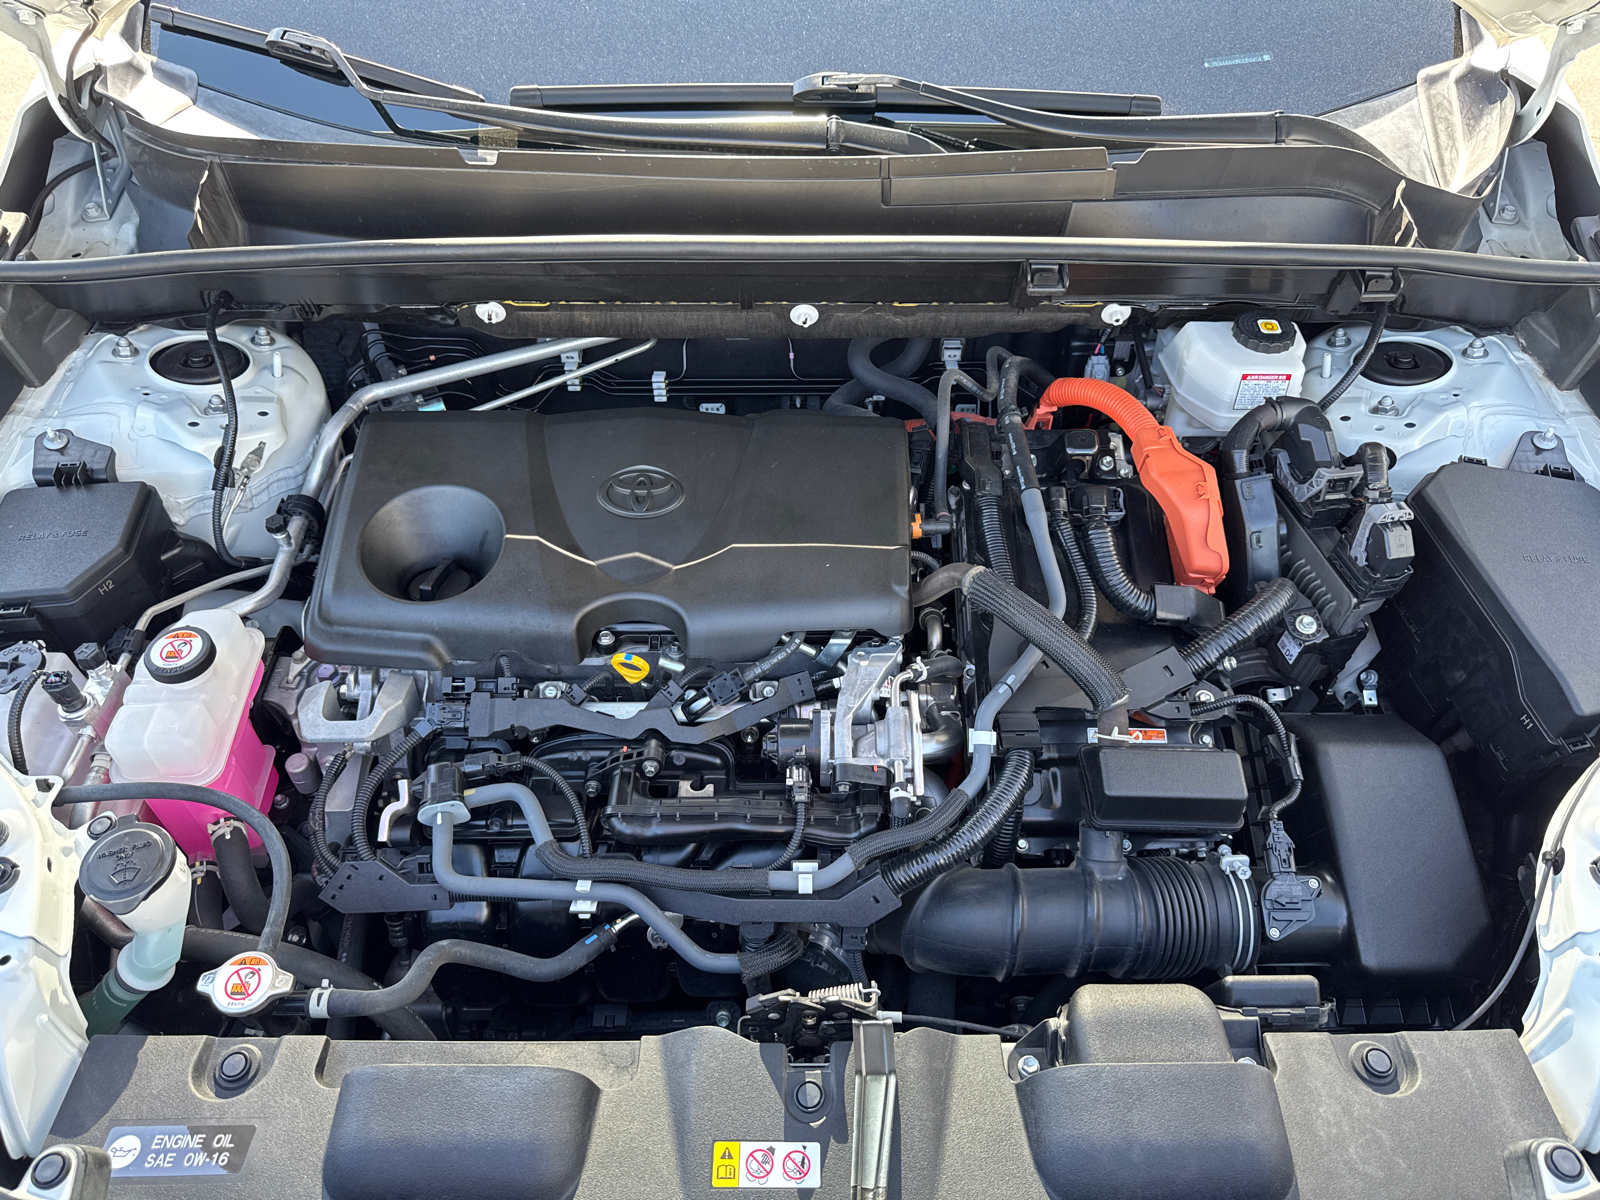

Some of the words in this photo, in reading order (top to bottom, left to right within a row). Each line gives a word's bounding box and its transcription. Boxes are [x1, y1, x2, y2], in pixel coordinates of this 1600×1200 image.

[17, 532, 51, 542] RELAY
[51, 531, 59, 539] &
[61, 529, 89, 538] FUSE
[1522, 554, 1554, 563] RELAY
[1563, 555, 1590, 564] FUSE
[97, 579, 116, 596] H2
[2, 646, 38, 657] COOLANT
[154, 665, 185, 674] DENSO
[1519, 713, 1534, 730] H1
[97, 846, 128, 860] WASHER
[132, 840, 153, 850] FLUID
[115, 851, 134, 861] ONLY
[151, 1134, 206, 1149] ENGINE
[213, 1133, 235, 1148] OIL
[144, 1153, 176, 1168] SAE
[183, 1152, 230, 1167] 0W-16
